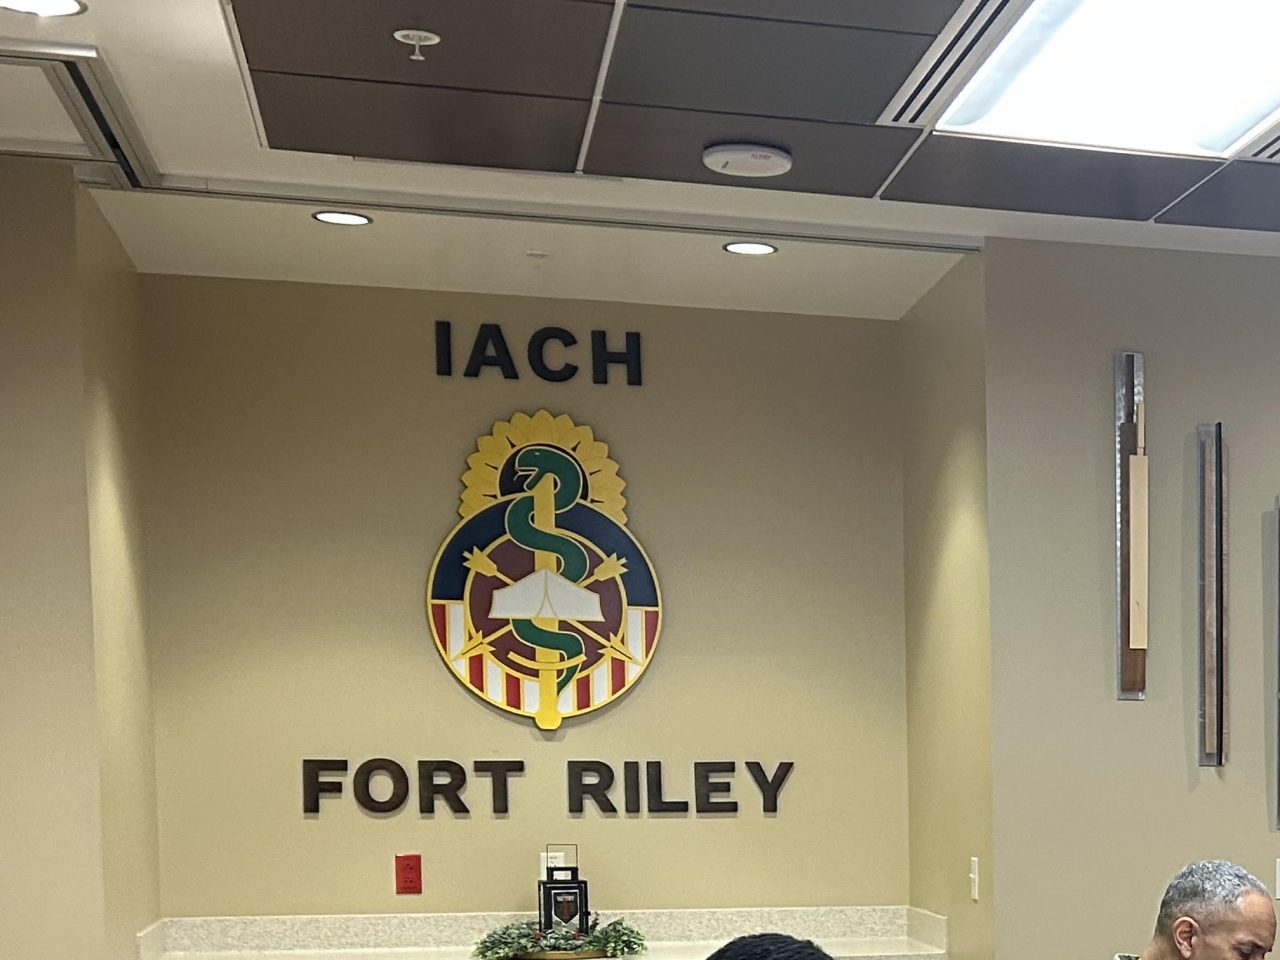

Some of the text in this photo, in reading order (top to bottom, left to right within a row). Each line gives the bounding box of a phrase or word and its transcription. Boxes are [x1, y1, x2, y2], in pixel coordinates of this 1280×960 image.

[435, 320, 642, 386] IACH
[302, 758, 795, 814] FORT RILEY
